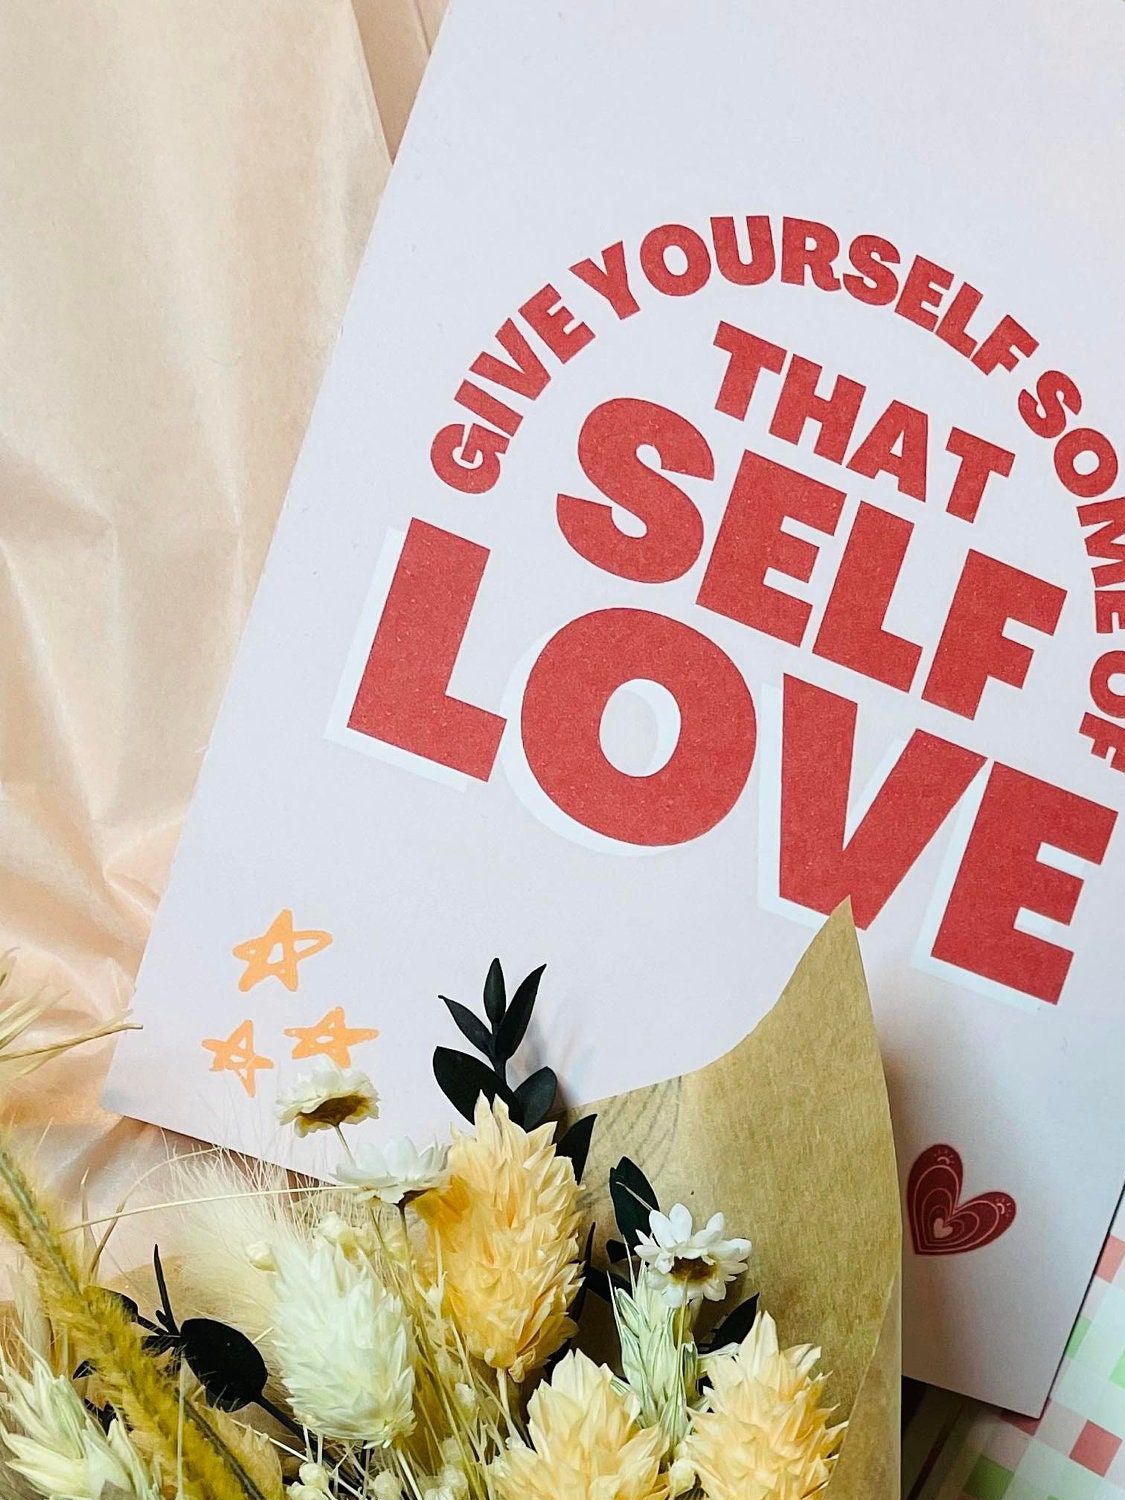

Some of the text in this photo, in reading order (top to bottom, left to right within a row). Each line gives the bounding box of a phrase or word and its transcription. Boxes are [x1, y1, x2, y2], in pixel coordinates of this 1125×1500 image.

[430, 284, 595, 495] GIVE
[571, 215, 1039, 377] YOURSELF
[712, 320, 1016, 524] THAT
[556, 397, 1067, 721] SELF
[346, 517, 1119, 1006] LOVE
